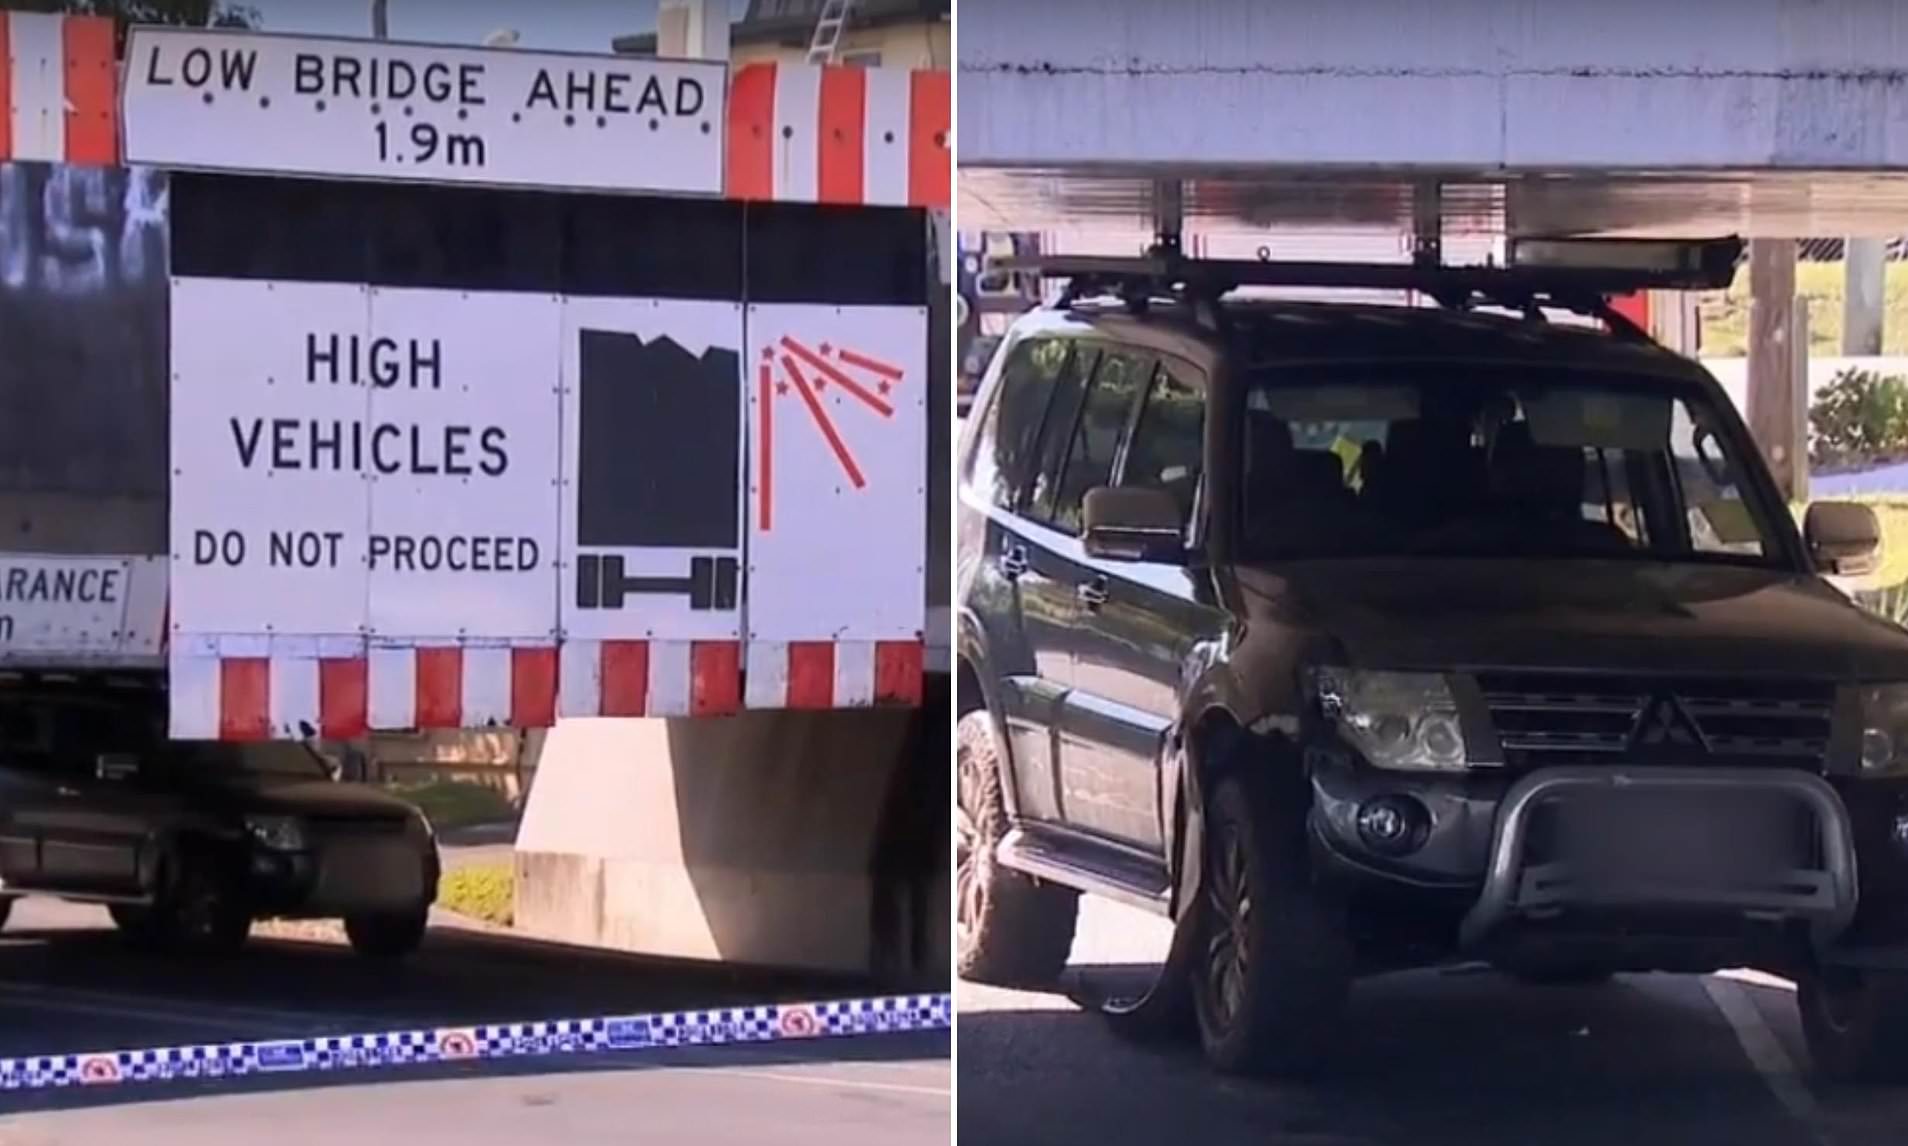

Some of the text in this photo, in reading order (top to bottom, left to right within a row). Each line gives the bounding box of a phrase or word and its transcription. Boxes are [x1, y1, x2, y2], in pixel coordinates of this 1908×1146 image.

[146, 45, 704, 118] LOW BRIDGE AHEAD
[374, 121, 486, 167] 1.9m
[307, 333, 442, 389] HIGH
[230, 417, 509, 477] VEHICLES
[194, 530, 540, 572] DO NOT PROCEED
[0, 567, 119, 603] RANCE
